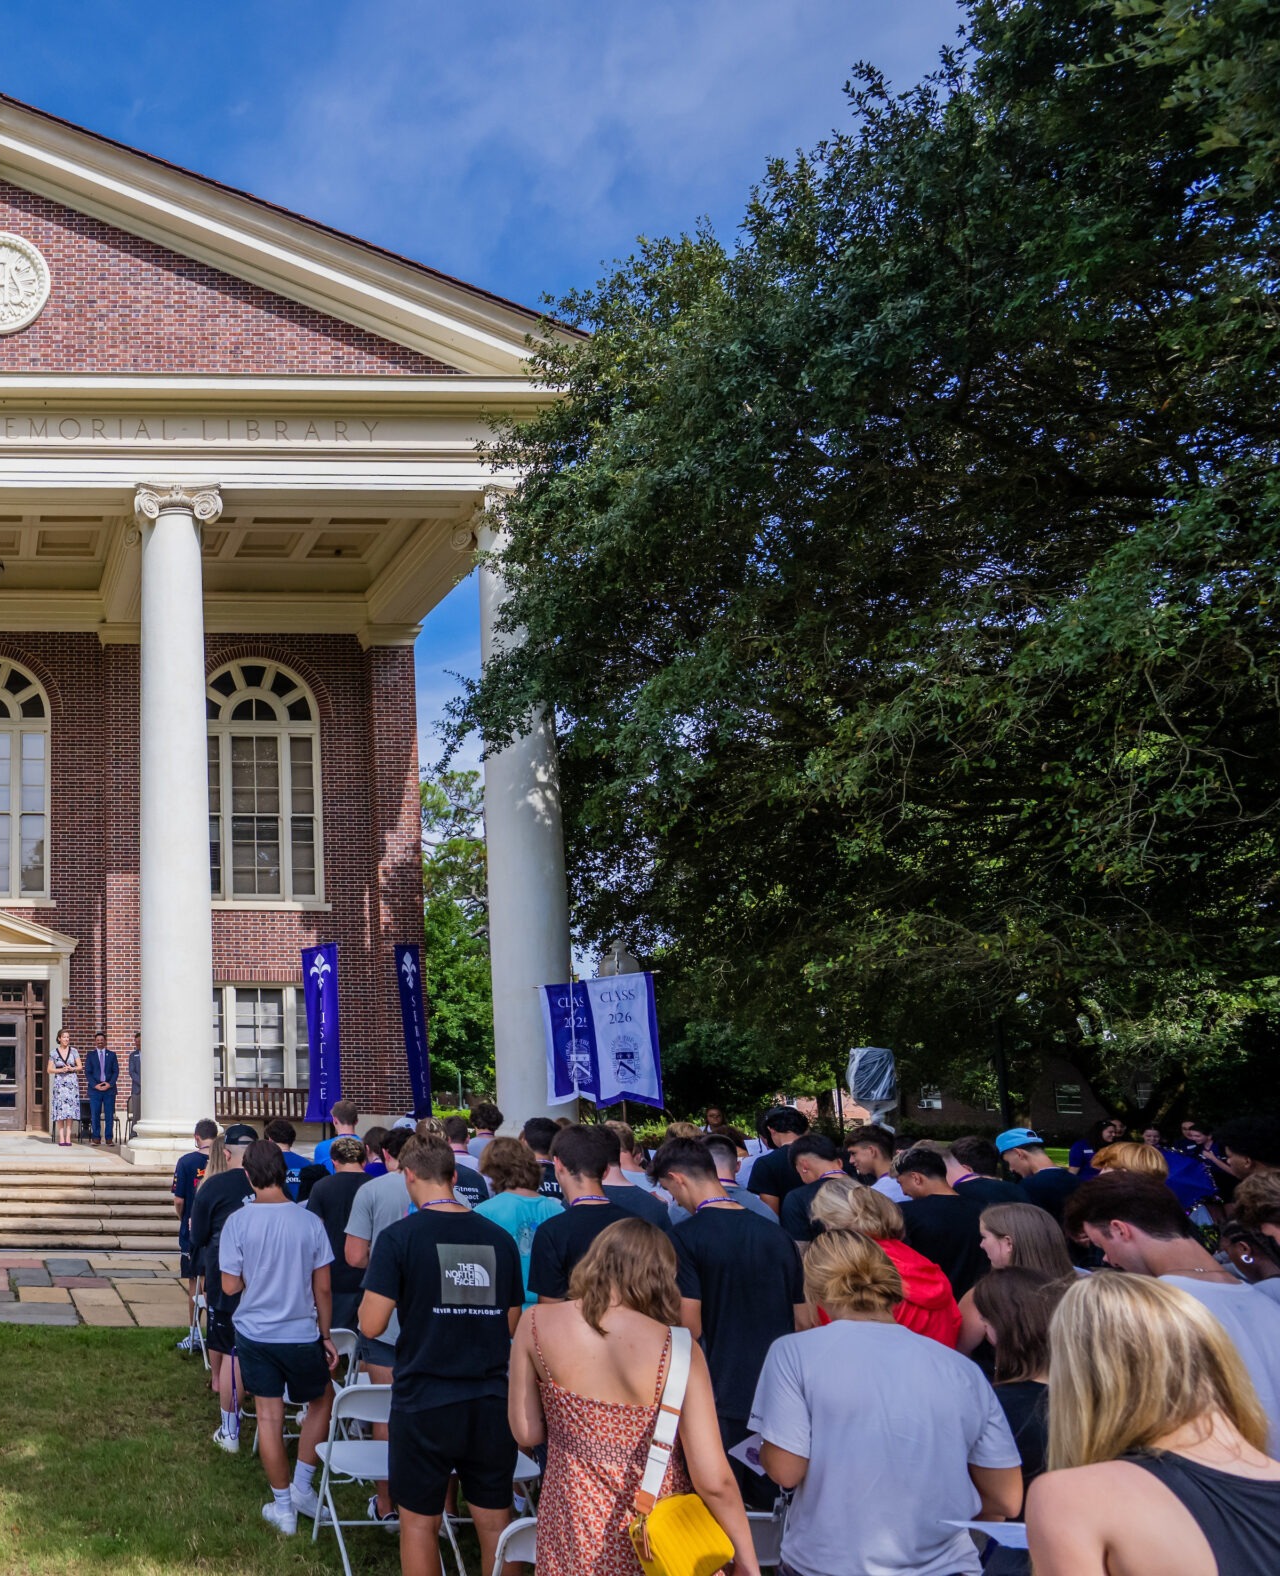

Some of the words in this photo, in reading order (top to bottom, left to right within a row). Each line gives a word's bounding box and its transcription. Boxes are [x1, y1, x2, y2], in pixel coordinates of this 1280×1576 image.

[201, 419, 380, 442] LIBRARY
[557, 996, 584, 1008] CLAS
[457, 1263, 474, 1271] THE
[445, 1270, 475, 1279] NORTH
[454, 1278, 475, 1287] FACE
